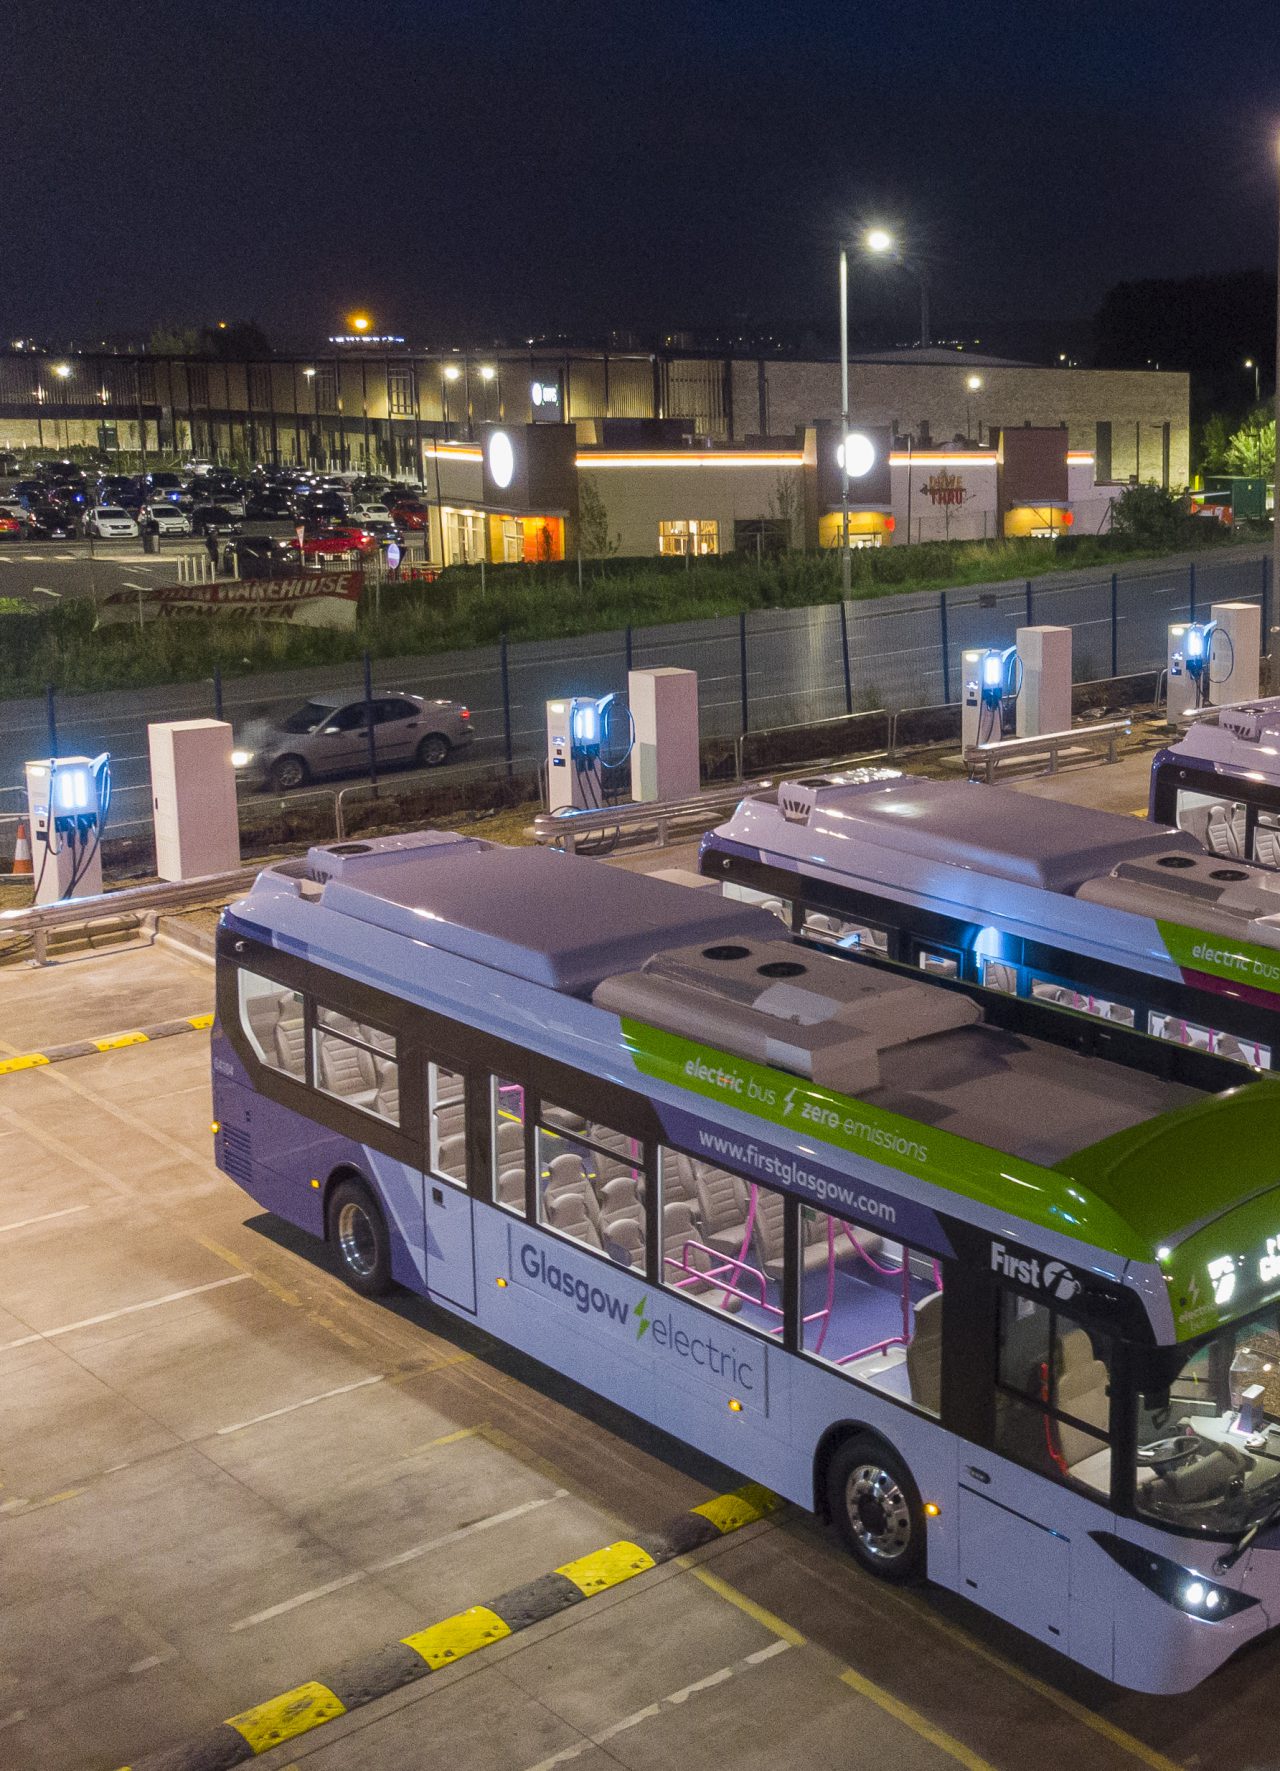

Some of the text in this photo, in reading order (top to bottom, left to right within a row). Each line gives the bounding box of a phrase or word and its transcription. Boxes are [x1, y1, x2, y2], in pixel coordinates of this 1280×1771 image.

[1192, 943, 1248, 971] electric
[1252, 959, 1280, 980] bus
[684, 1057, 928, 1163] electric bus zero emissions
[699, 1129, 897, 1223] www.firstglasgow.com
[991, 1241, 1040, 1289] First
[520, 1243, 753, 1390] Glasgow electric
